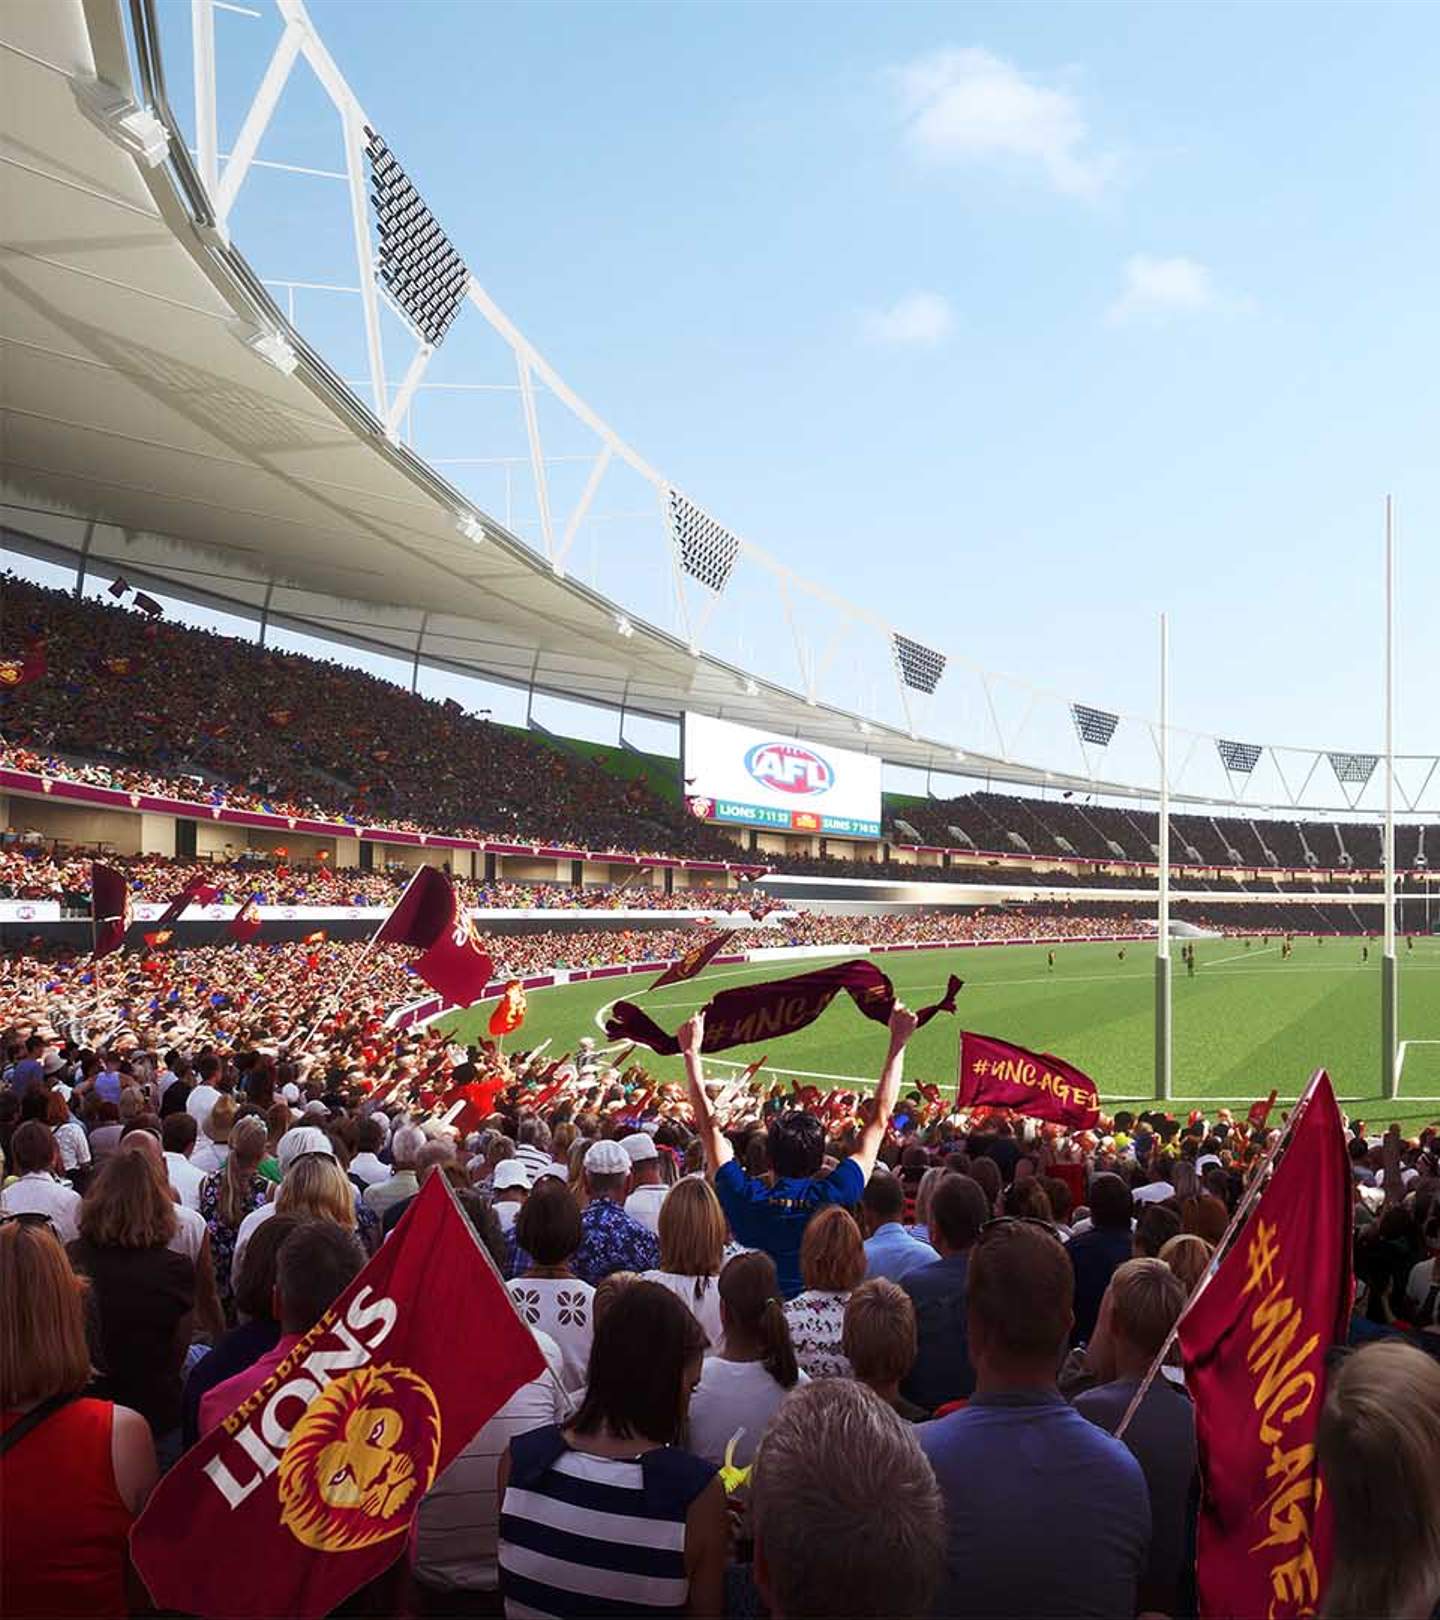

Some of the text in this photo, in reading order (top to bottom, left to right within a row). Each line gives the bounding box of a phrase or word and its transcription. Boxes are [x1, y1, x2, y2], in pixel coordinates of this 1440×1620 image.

[752, 751, 830, 791] AFL
[720, 804, 756, 818] LIONS
[823, 818, 850, 831] SUNS
[203, 1285, 397, 1510] LIONS
[1241, 1219, 1322, 1620] #UNCAGE
